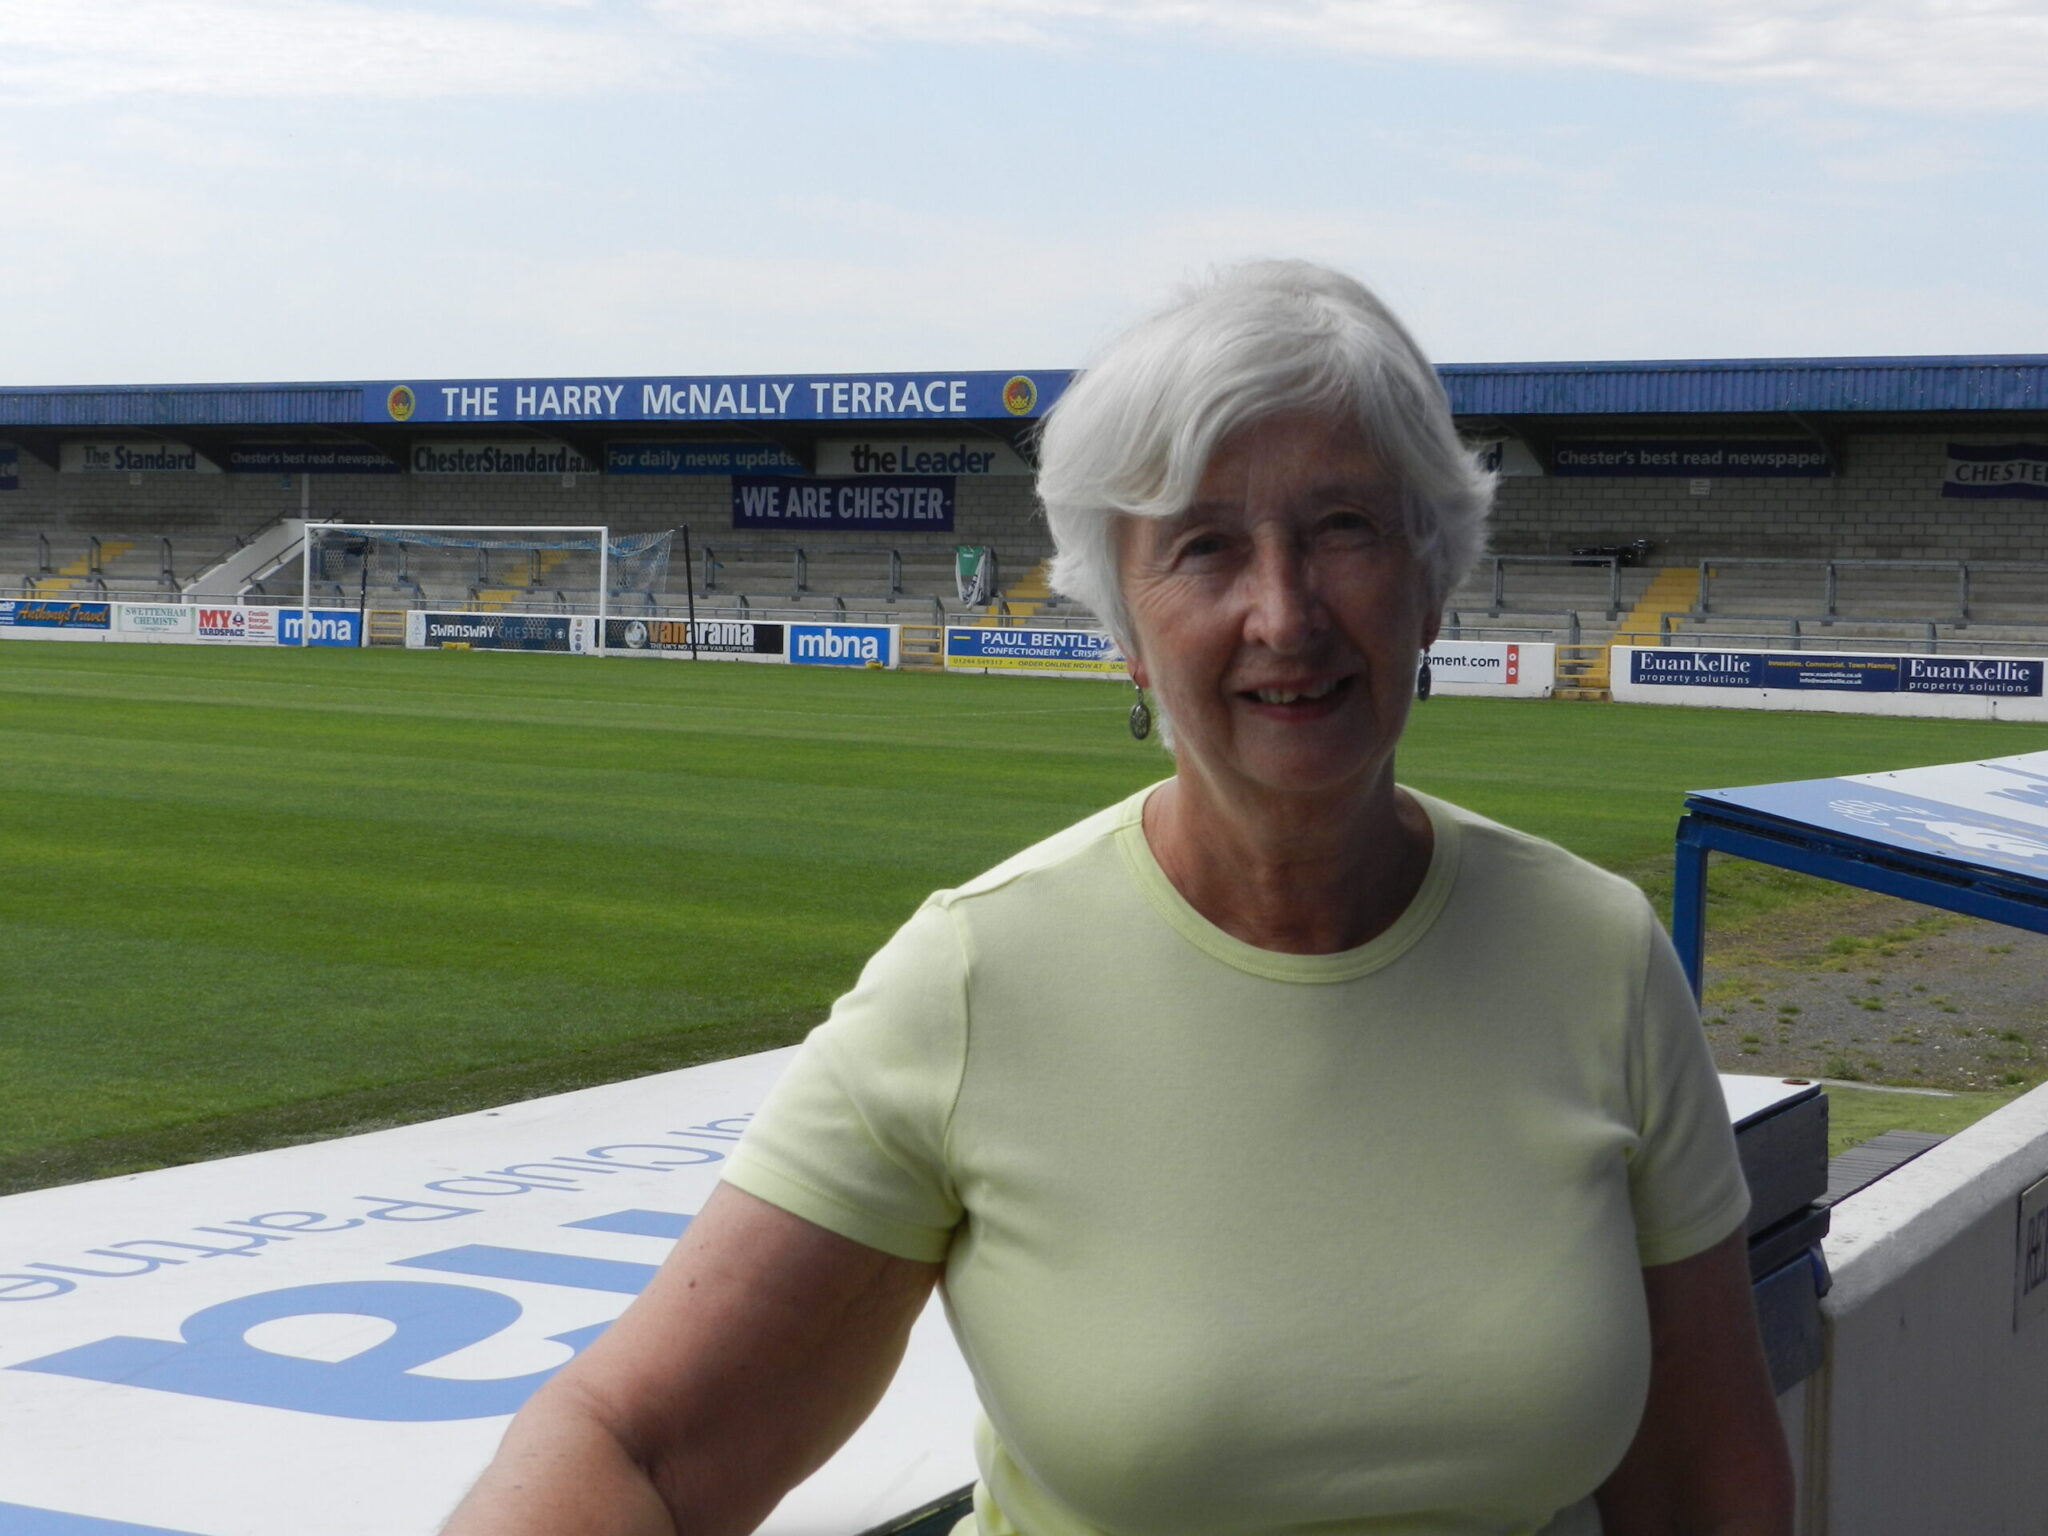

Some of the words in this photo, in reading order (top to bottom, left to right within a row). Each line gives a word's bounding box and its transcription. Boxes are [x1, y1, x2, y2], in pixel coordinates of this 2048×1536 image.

[441, 387, 498, 416] THE
[516, 385, 624, 415] HARRY
[643, 383, 794, 414] McNALLY
[810, 381, 967, 412] TERRACE
[84, 445, 110, 464] The
[115, 445, 196, 470] Standard
[283, 452, 305, 464] best
[308, 452, 335, 464] read
[609, 451, 636, 466] For
[640, 450, 681, 470] daily
[686, 453, 731, 466] news
[736, 449, 800, 469] update
[851, 444, 896, 473] the
[901, 444, 995, 473] Leader
[1558, 450, 1635, 465] Chester's
[1640, 451, 1678, 465] best
[1683, 451, 1722, 465] read
[741, 486, 780, 518] WE
[785, 487, 832, 518] ARE
[838, 487, 945, 519] CHESTER
[125, 607, 187, 617] SWETTENHAM
[133, 616, 178, 625] CHEMISTS
[199, 609, 232, 628] MY
[199, 628, 245, 637] YARDSPACE
[285, 612, 351, 641] mbna
[430, 624, 495, 638] SWANSWAY
[498, 627, 552, 639] CHESTER
[649, 621, 755, 645] vanarama
[798, 628, 878, 659] mbna
[981, 632, 1026, 646] PAUL
[1031, 633, 1109, 649] BENTLEY
[982, 646, 1061, 657] CONFECTIONERY
[1640, 652, 1751, 673] EuanKellie
[1909, 659, 2030, 681] EuanKellie
[1640, 673, 1691, 683] property
[1695, 674, 1750, 684] solutions
[1909, 682, 1965, 692] property
[1969, 682, 2029, 693] solutions
